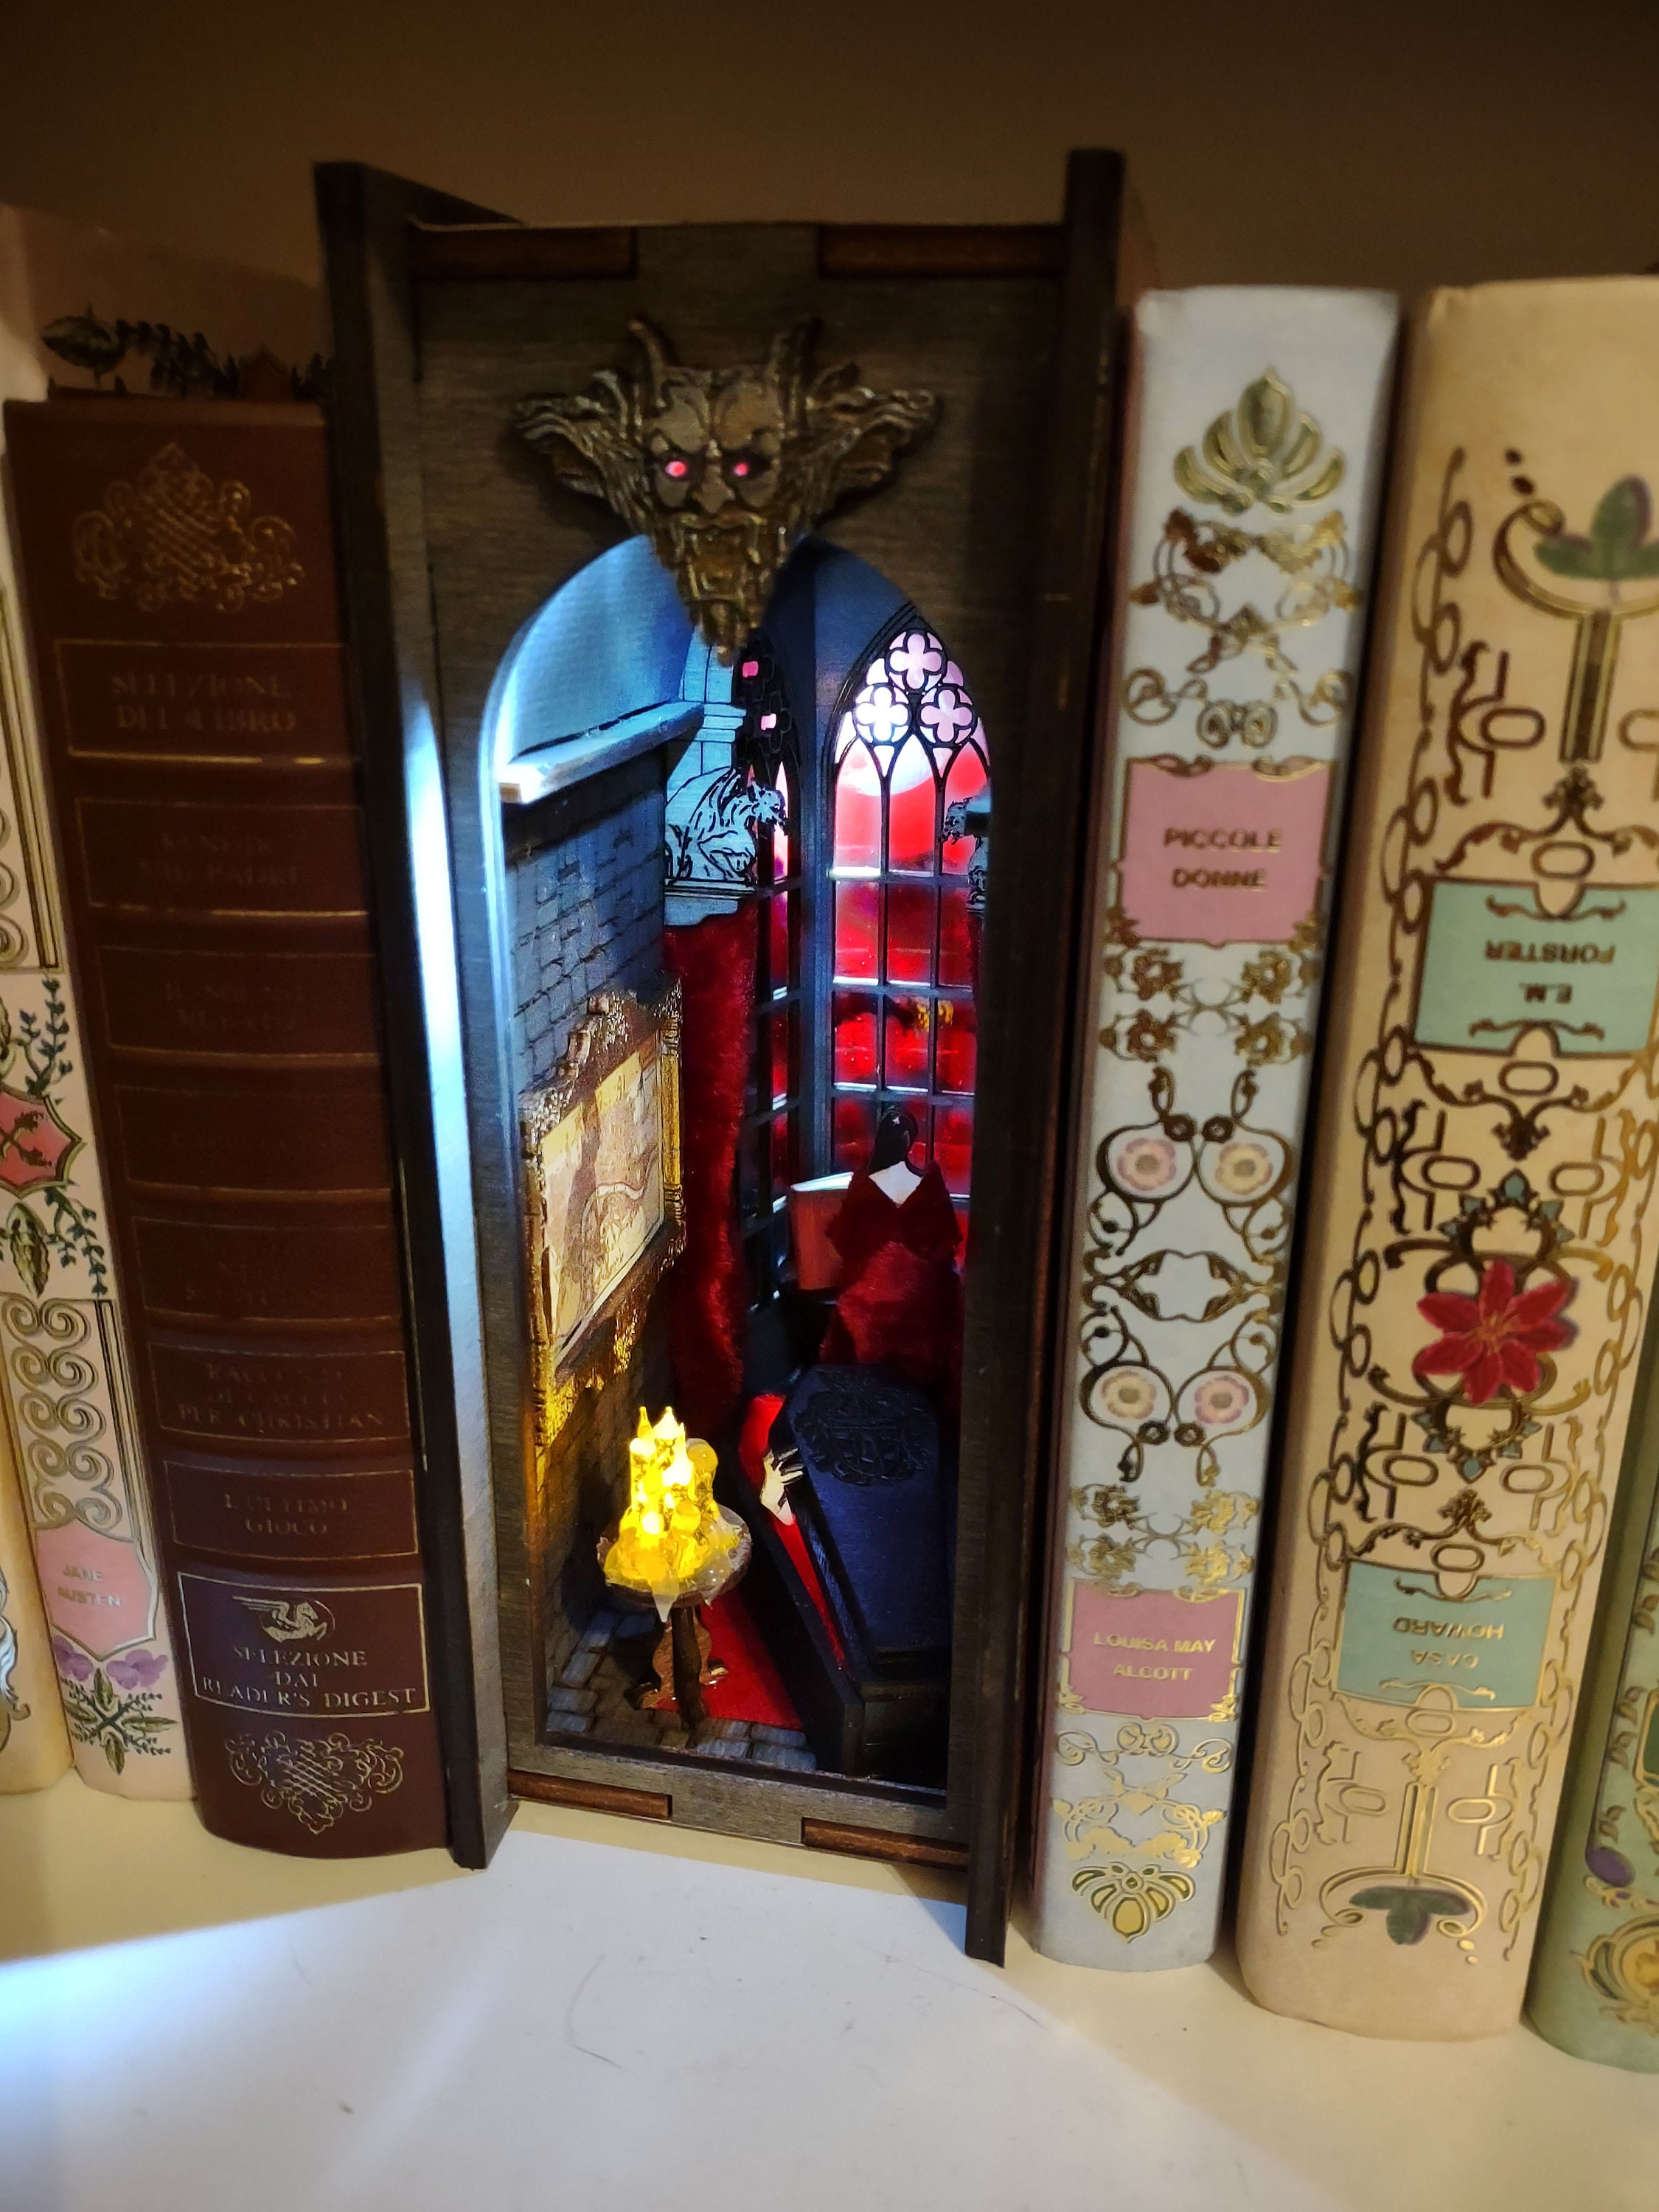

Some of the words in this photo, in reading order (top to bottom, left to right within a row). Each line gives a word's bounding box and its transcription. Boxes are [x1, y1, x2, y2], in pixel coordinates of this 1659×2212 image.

[1164, 827, 1282, 852] PICCOLE
[1172, 869, 1267, 891] DONNE
[1484, 940, 1615, 964] FORSTER
[63, 1565, 104, 1582] JANE
[58, 1587, 121, 1608] AUSTEN
[1392, 1616, 1505, 1640] HOWARD
[1093, 1632, 1169, 1652] LOUISA
[1174, 1638, 1216, 1652] MAY
[1410, 1649, 1479, 1669] CASA
[1113, 1663, 1194, 1681] ALCOTT
[324, 1688, 417, 1708] DIGEST
